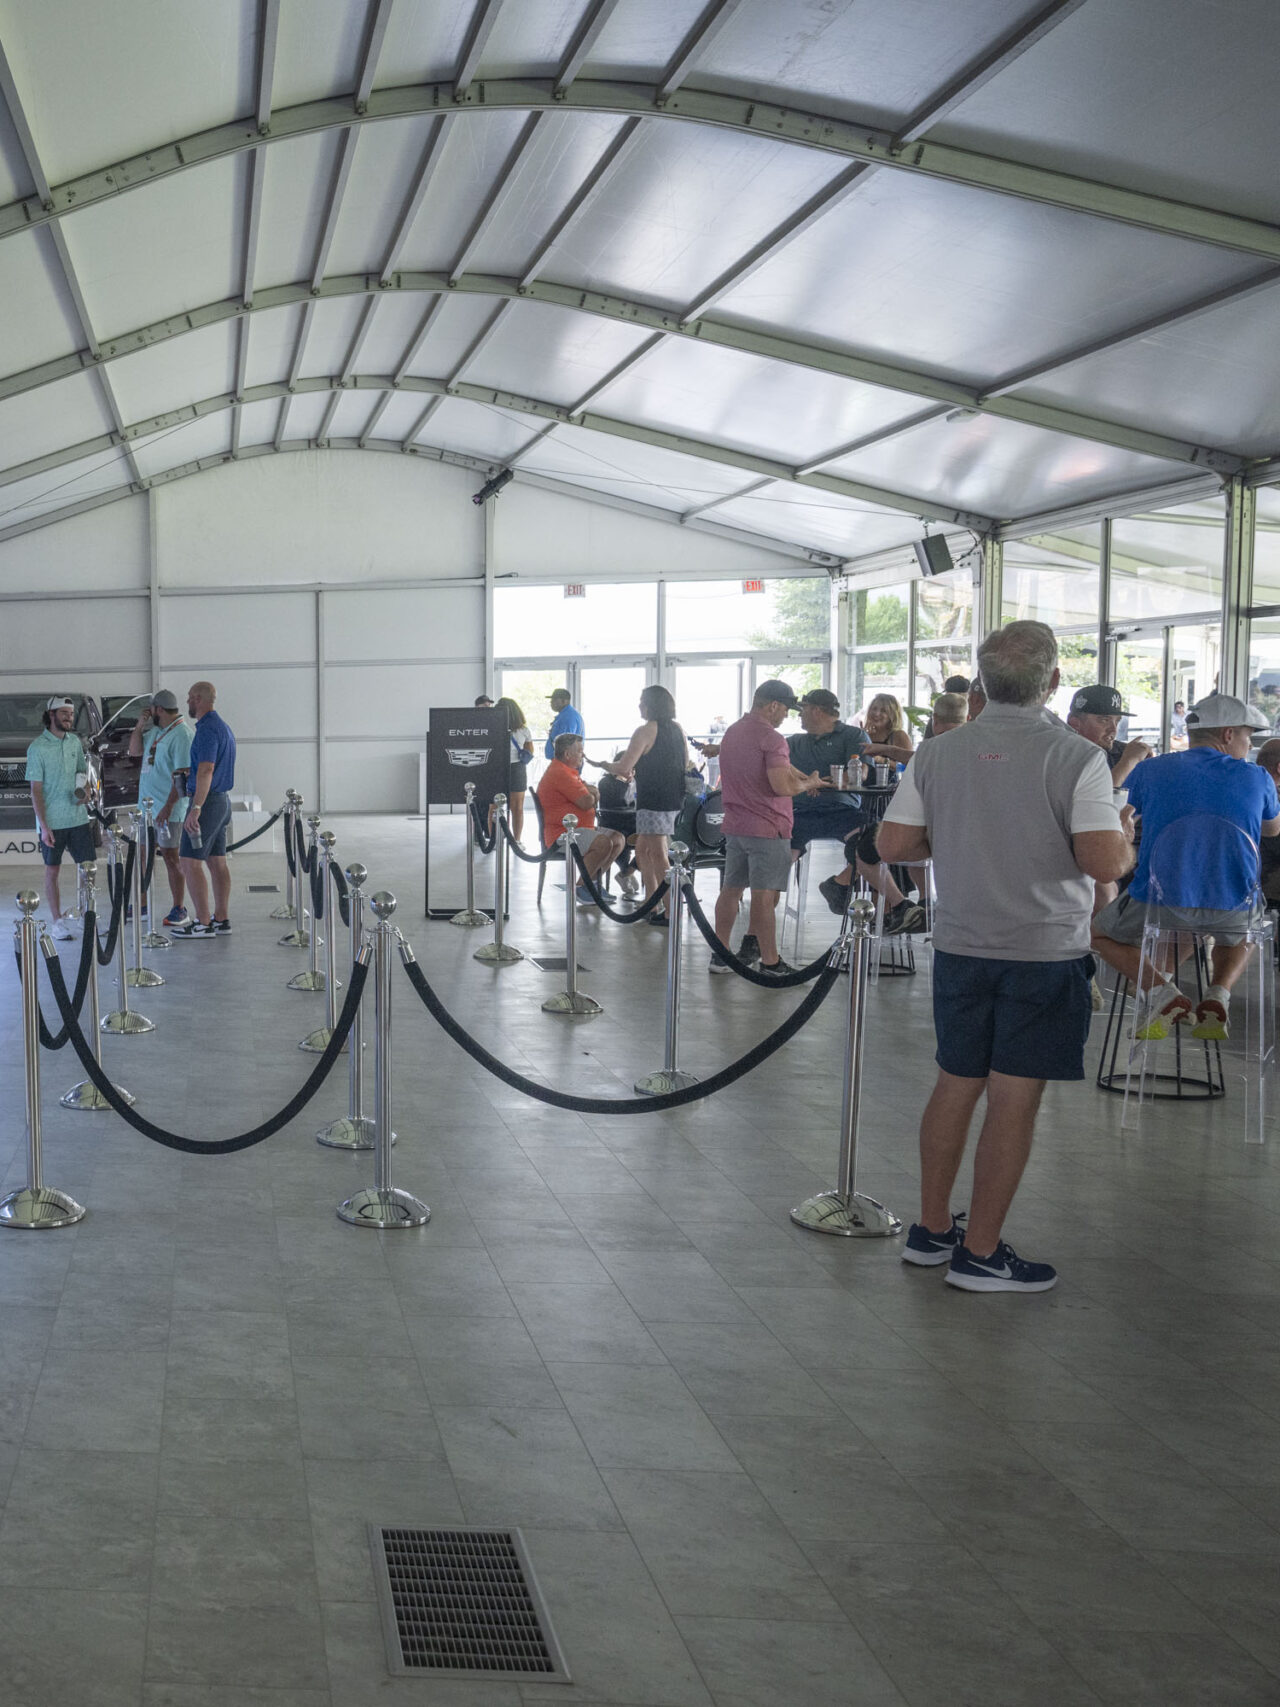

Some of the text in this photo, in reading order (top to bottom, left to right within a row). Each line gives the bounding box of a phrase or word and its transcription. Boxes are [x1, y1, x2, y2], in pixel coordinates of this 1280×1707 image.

[567, 584, 582, 595] EXIT
[745, 580, 761, 591] EXIT
[448, 728, 489, 736] ENTER
